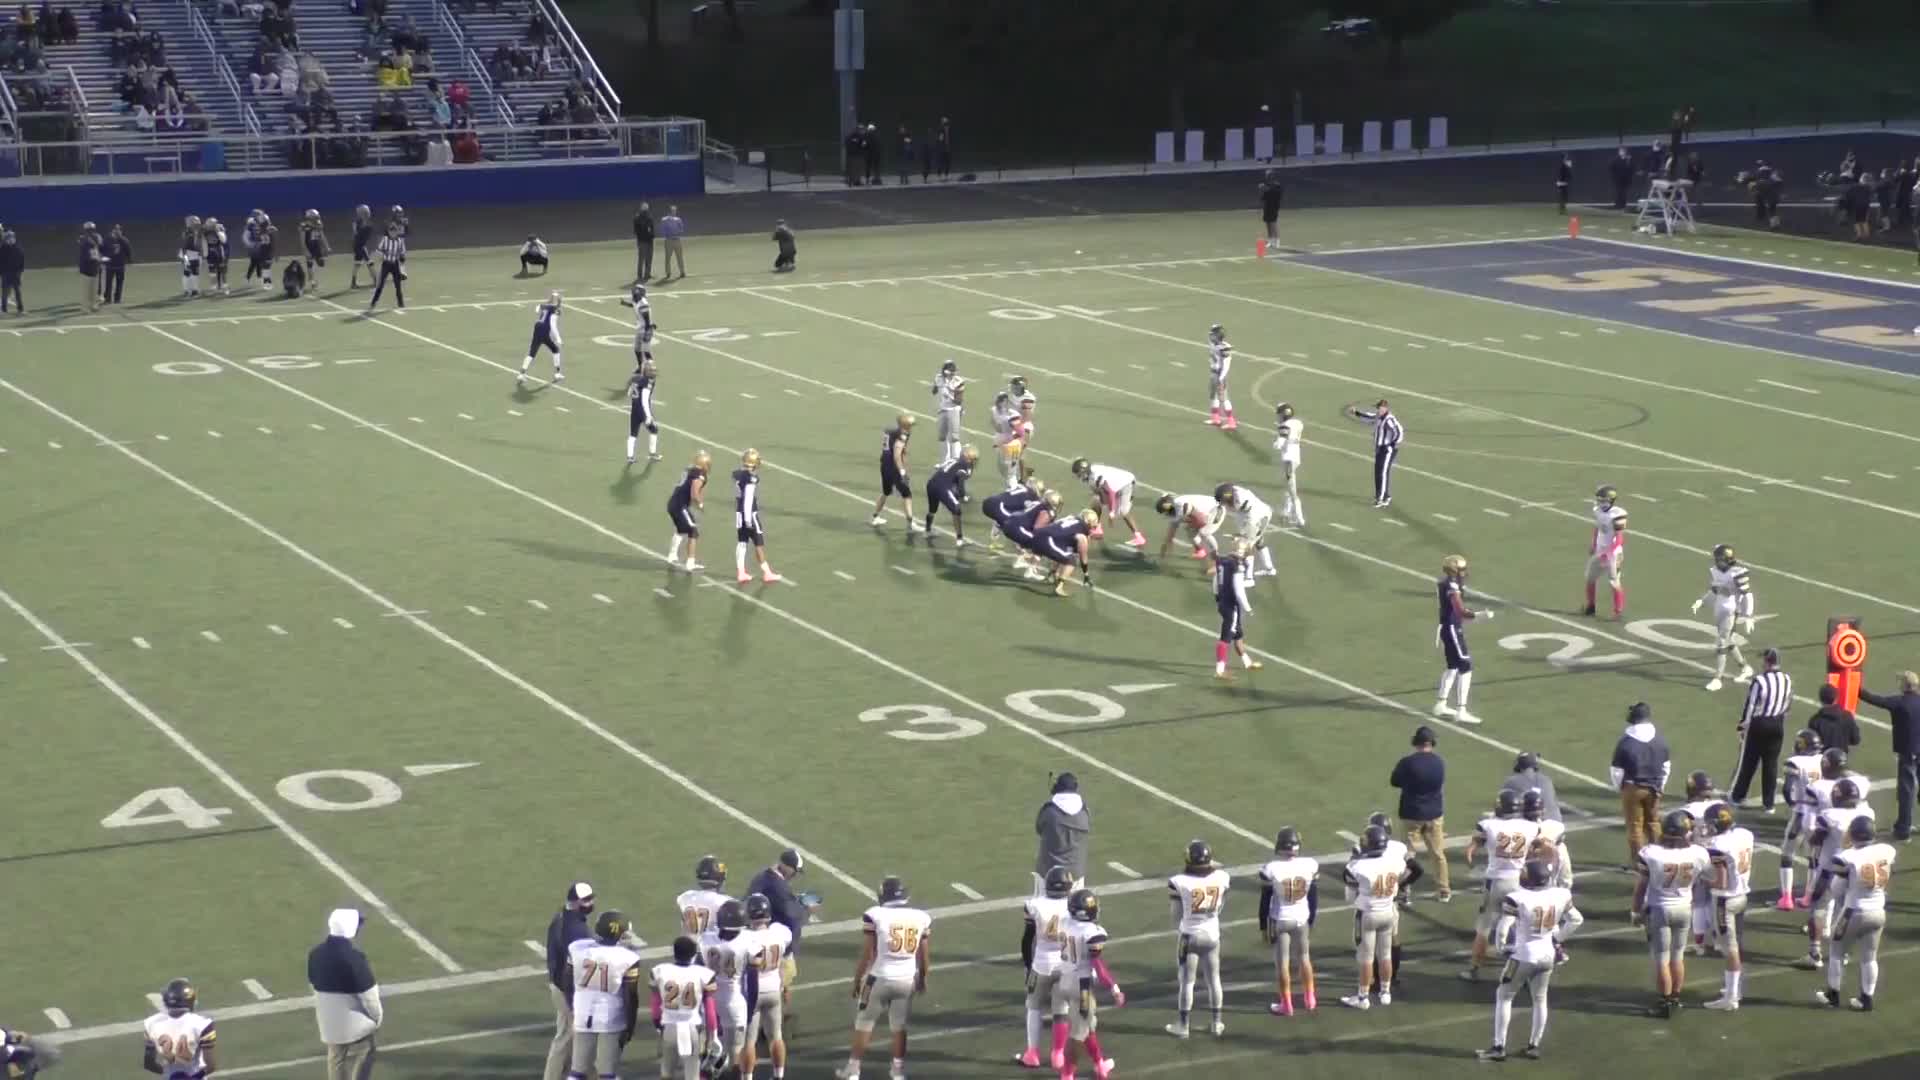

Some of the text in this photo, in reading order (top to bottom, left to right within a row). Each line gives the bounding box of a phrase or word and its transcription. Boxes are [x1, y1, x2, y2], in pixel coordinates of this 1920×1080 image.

[1496, 831, 1526, 858] 22
[1191, 886, 1220, 913] 27
[582, 959, 608, 992] 71
[664, 980, 696, 1010] 24
